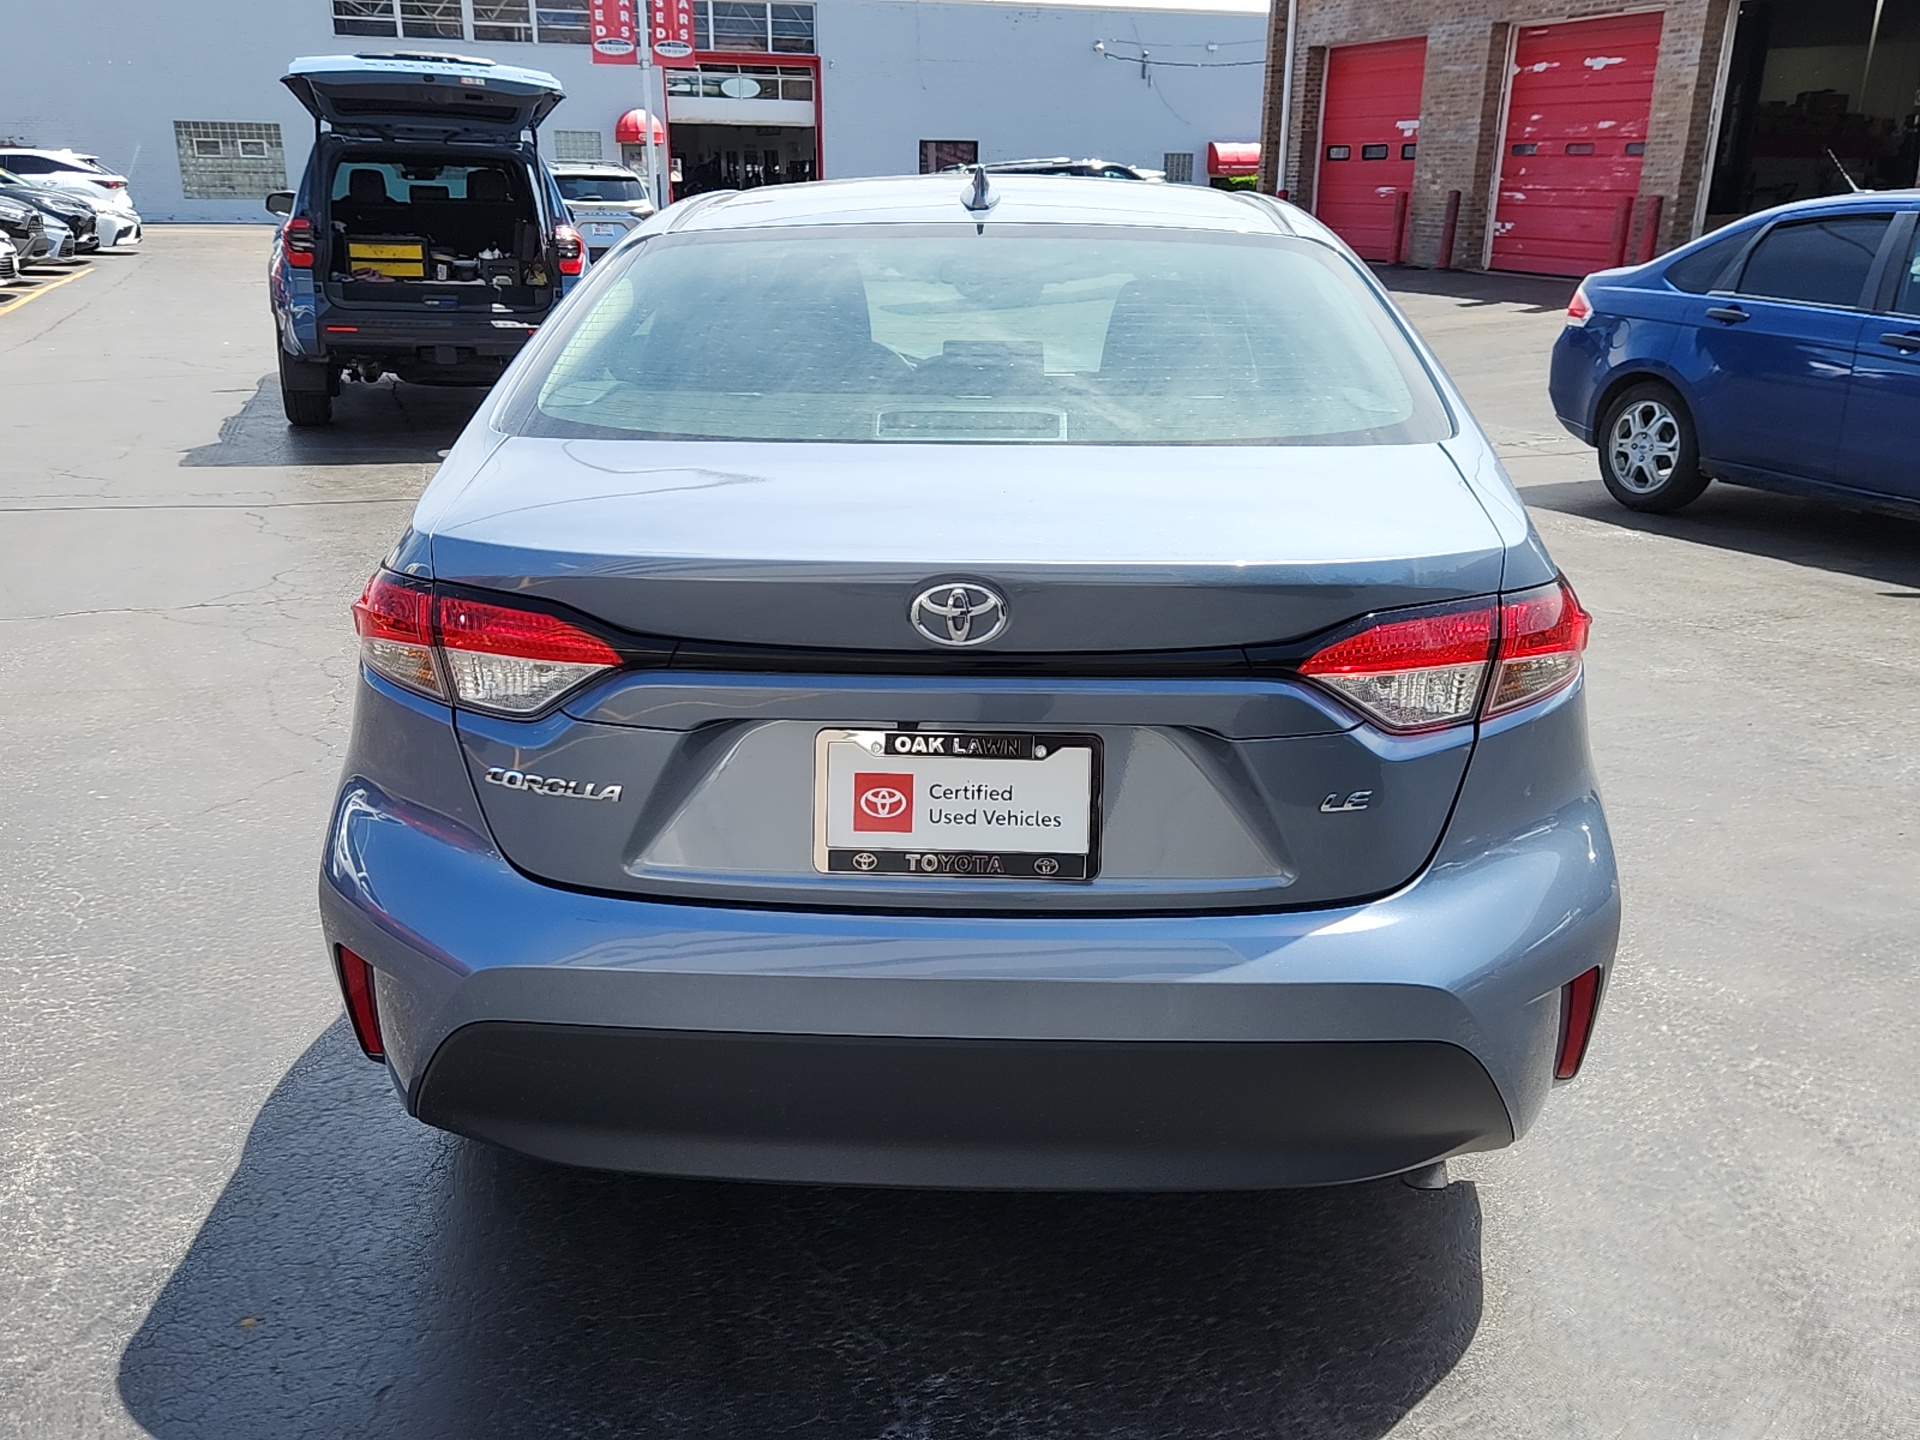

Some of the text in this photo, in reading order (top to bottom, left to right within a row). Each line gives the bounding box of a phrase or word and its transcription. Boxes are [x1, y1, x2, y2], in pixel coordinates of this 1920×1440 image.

[678, 0, 690, 40] ARS
[894, 736, 1021, 756] OAK LAWN
[484, 766, 623, 802] COROLLA
[928, 784, 1013, 802] Certified
[1320, 790, 1373, 812] LE
[928, 809, 1062, 828] Used Vehicles
[905, 854, 1005, 874] TOYOTA
